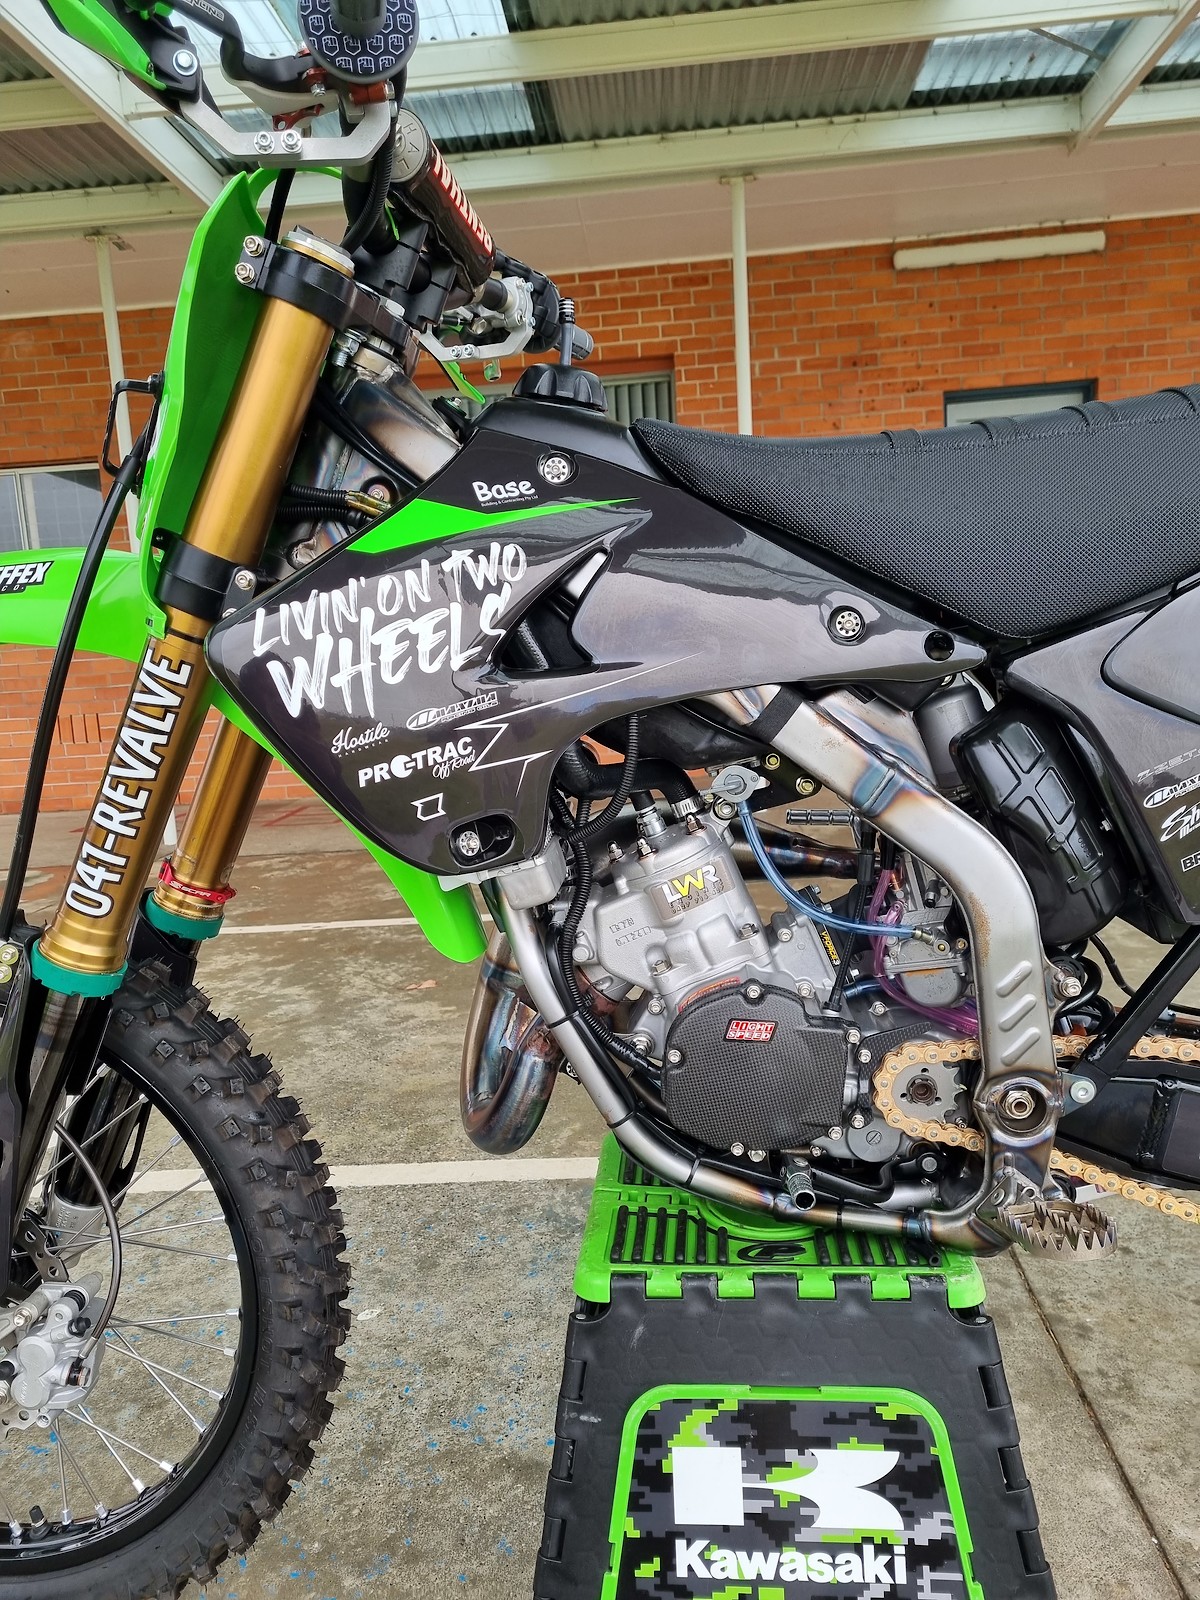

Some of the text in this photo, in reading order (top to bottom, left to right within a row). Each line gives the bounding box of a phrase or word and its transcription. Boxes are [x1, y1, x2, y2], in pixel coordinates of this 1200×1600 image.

[472, 480, 536, 501] Base
[0, 562, 52, 585] FFEX
[377, 558, 431, 616] ON
[441, 542, 527, 598] TWO
[265, 582, 513, 718] WHEELS
[331, 721, 390, 754] Hostile
[451, 750, 476, 771] Road
[661, 864, 720, 903] LWR
[726, 1030, 772, 1041] SPEED
[731, 1021, 775, 1032] LIGHT
[674, 1538, 907, 1585] Kawasaki
